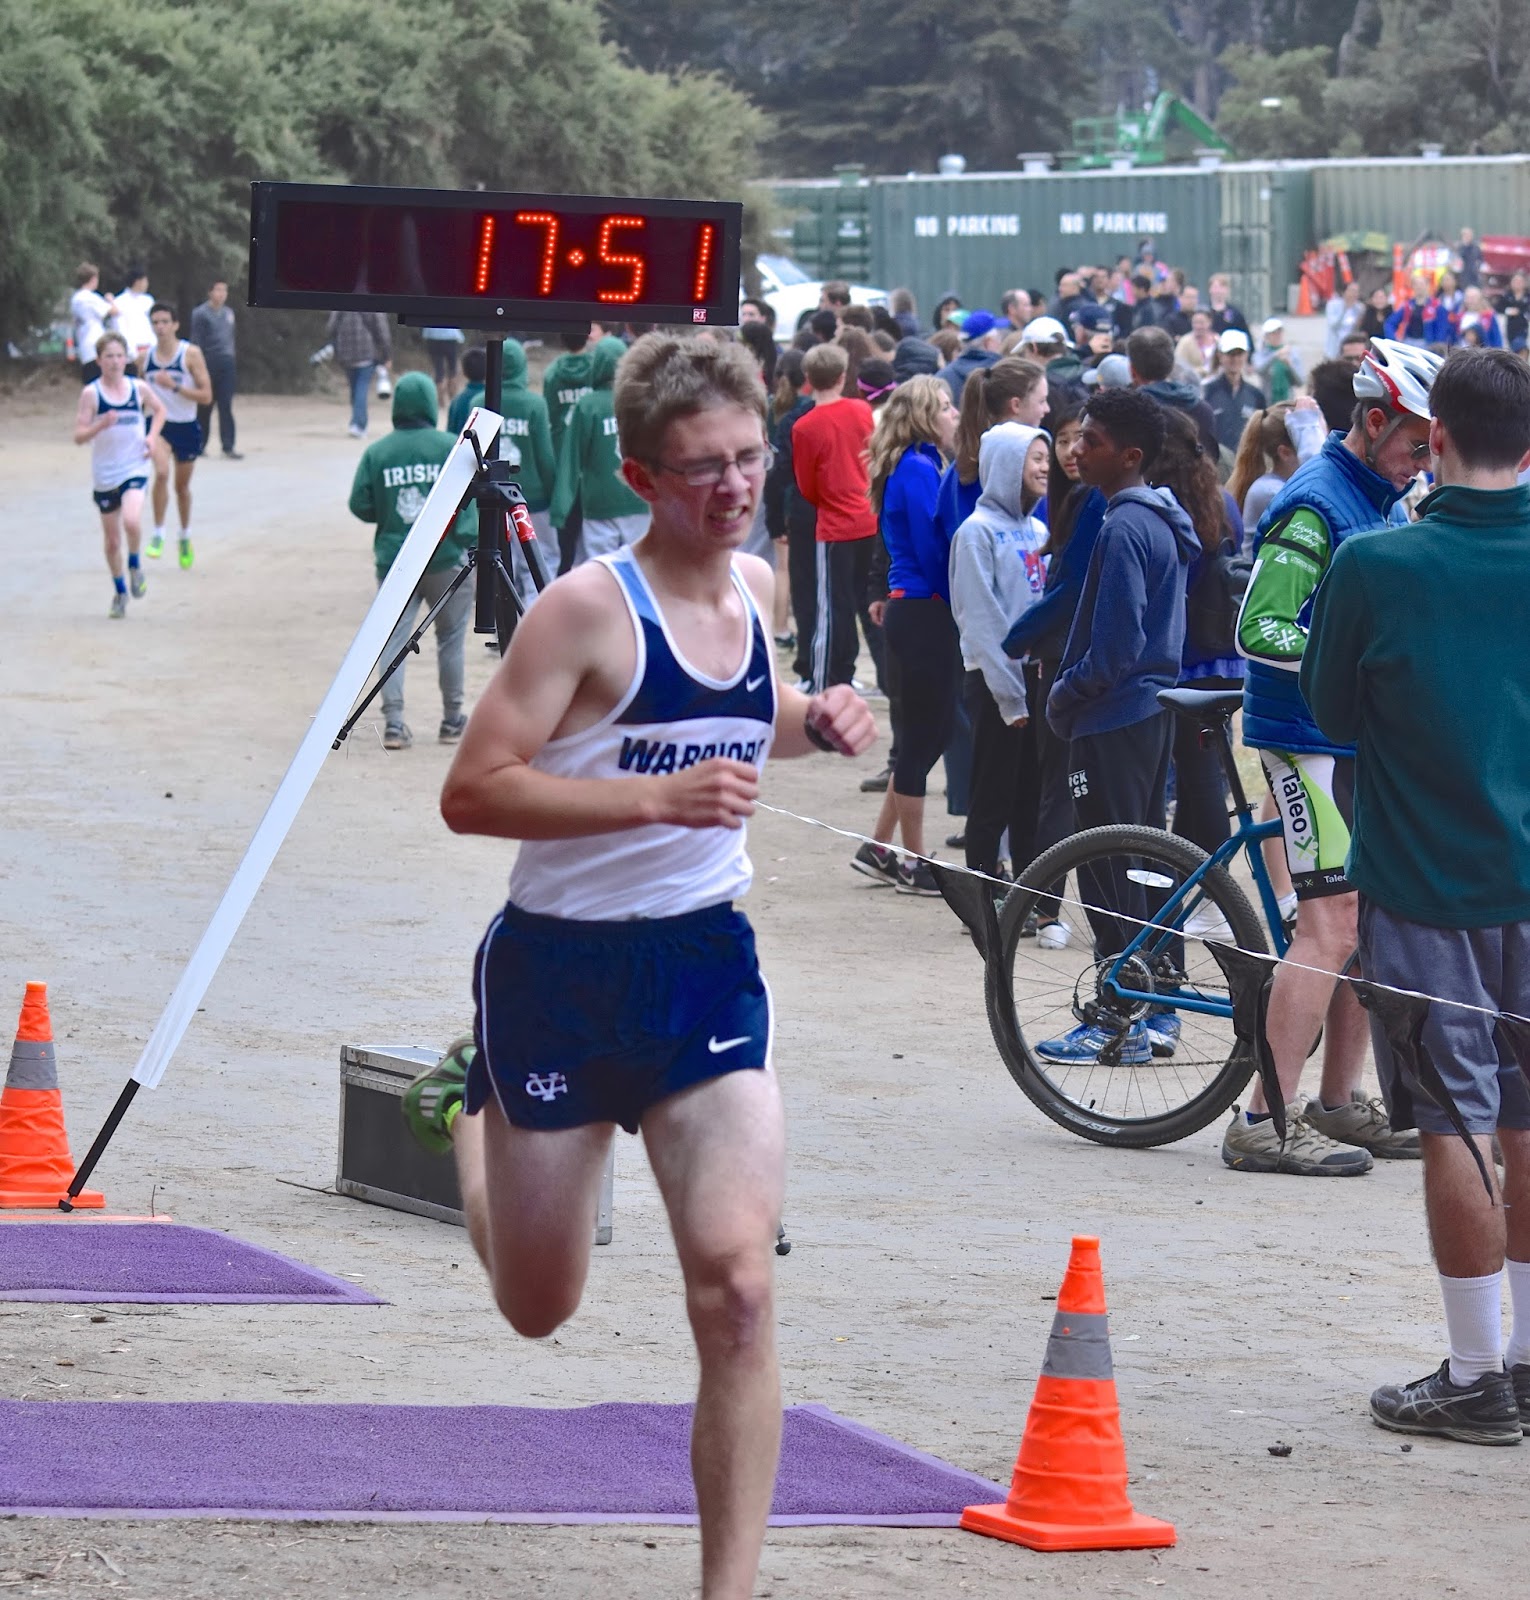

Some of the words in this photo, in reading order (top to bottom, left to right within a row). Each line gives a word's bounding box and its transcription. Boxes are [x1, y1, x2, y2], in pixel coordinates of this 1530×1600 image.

[915, 216, 939, 237] NO
[947, 214, 1020, 236] PARKING
[1060, 213, 1084, 234] NO
[1093, 212, 1168, 233] PARKING
[500, 417, 529, 437] ISH
[382, 464, 441, 488] IRISH
[1281, 767, 1307, 833] Taleo
